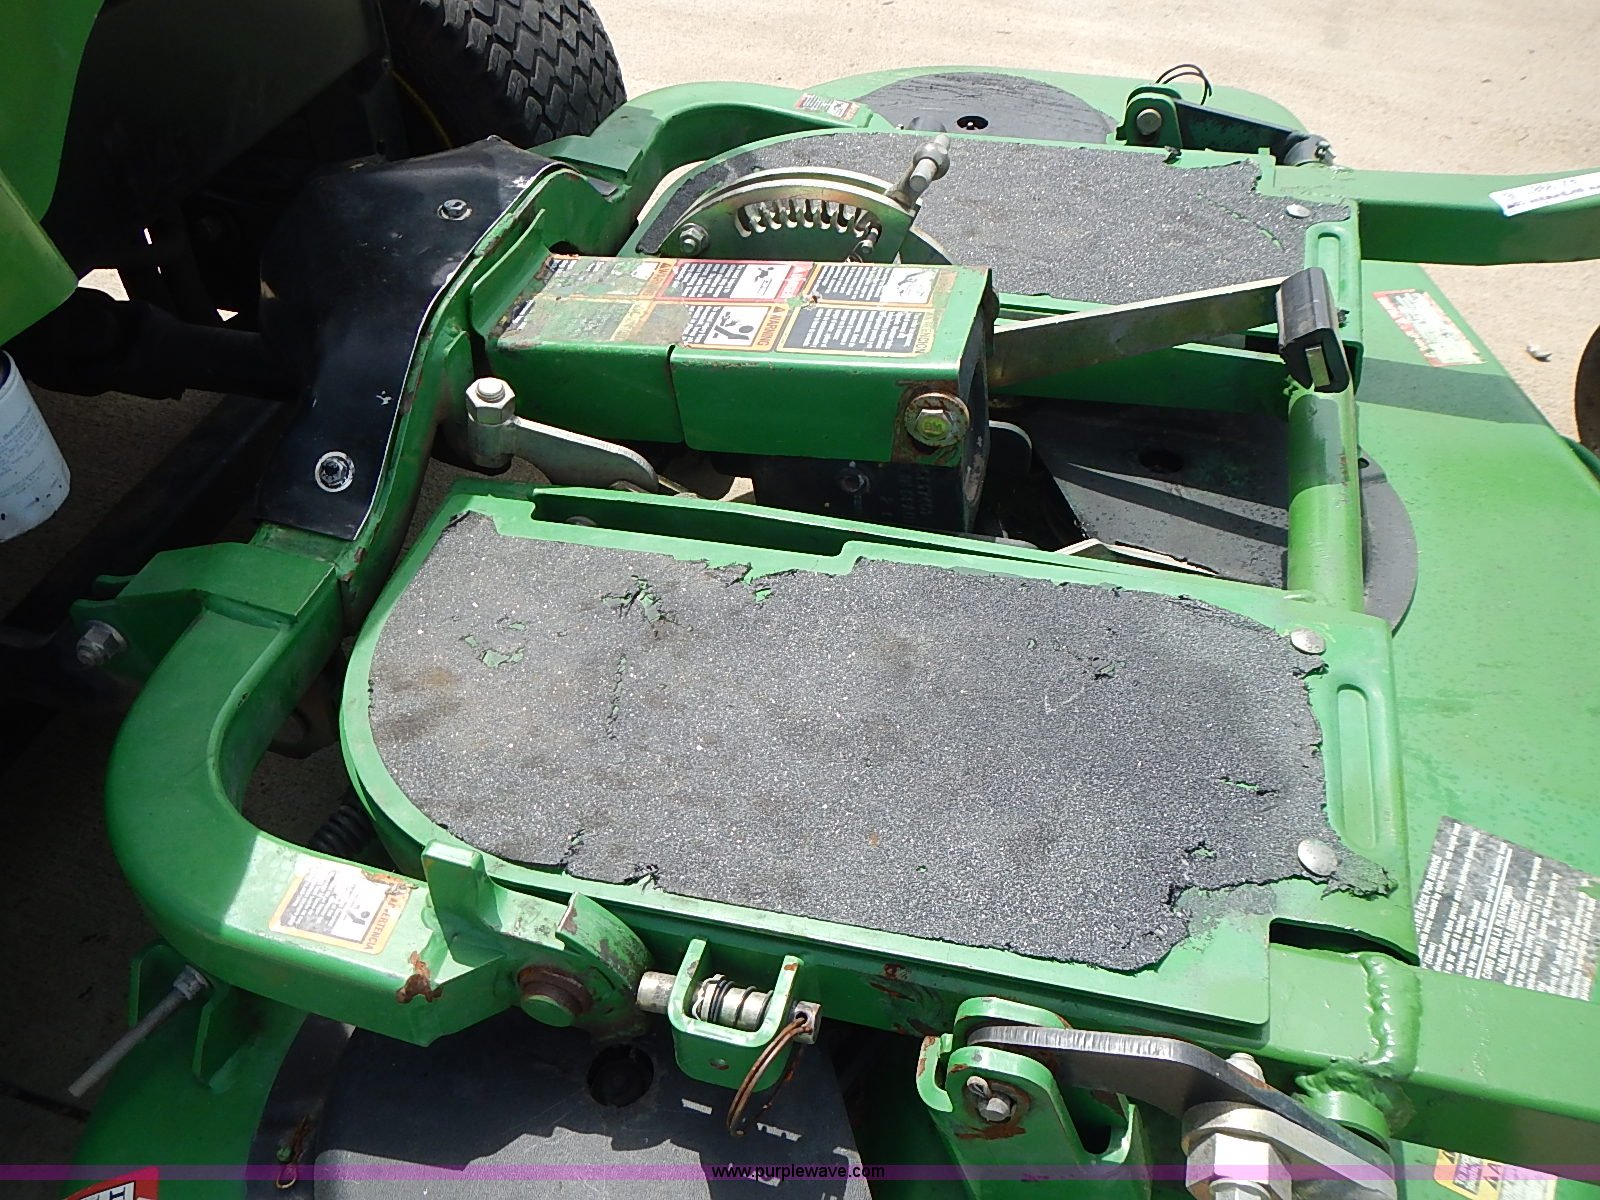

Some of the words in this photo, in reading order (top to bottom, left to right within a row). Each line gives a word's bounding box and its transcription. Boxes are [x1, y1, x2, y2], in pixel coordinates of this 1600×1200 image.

[763, 310, 787, 347] WARNING
[1426, 854, 1442, 879] SERVICE
[1421, 879, 1434, 894] FOR
[1481, 957, 1495, 979] COMO
[1493, 926, 1504, 936] LA
[1494, 953, 1509, 973] PARA
